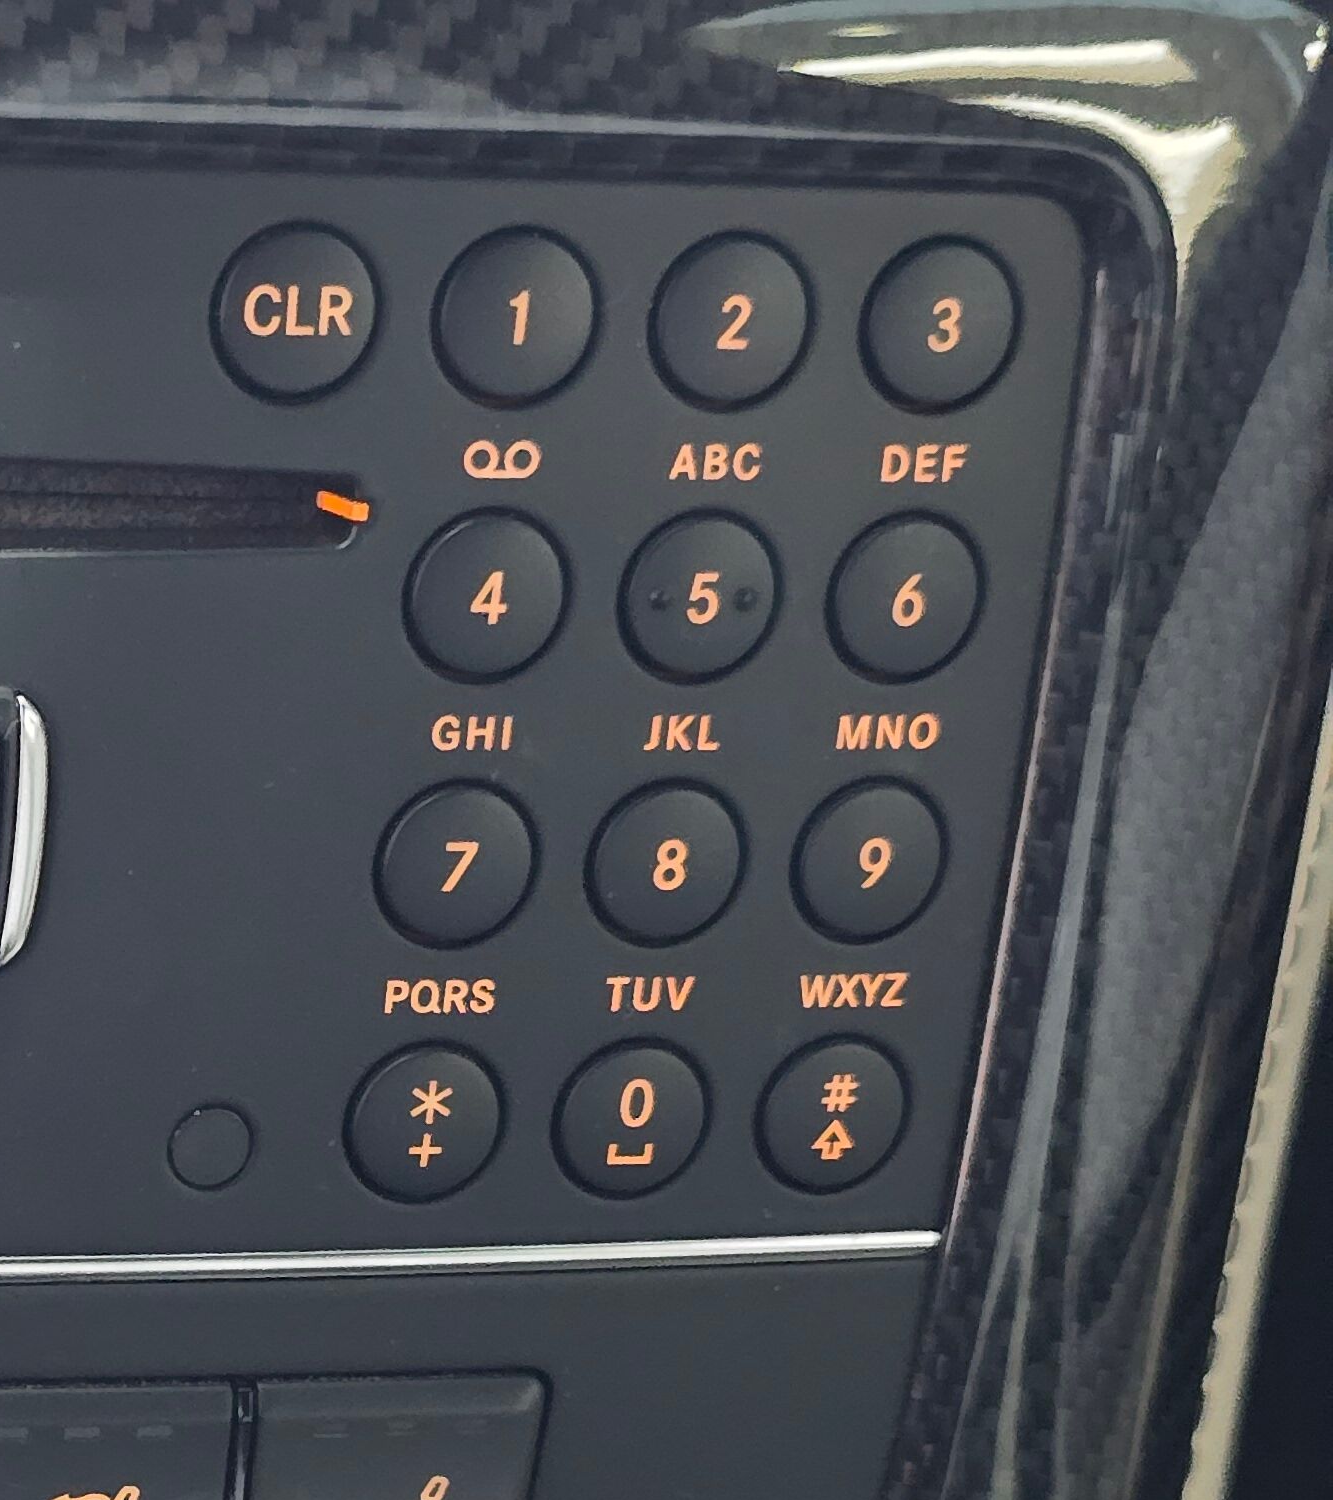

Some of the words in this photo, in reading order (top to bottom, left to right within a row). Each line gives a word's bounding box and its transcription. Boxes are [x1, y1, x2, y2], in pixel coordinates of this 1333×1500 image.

[243, 283, 354, 337] CLR
[509, 290, 530, 346] 1
[716, 294, 753, 350] 2
[927, 297, 962, 353] 3
[669, 443, 761, 481] ABC
[880, 443, 968, 483] DEF
[470, 570, 508, 625] 4
[686, 571, 720, 625] 5
[892, 573, 925, 627] 6
[431, 714, 513, 752] GHI
[643, 714, 720, 751] JKL
[835, 712, 940, 750] MNO
[441, 841, 480, 892] 7
[652, 839, 688, 891] 8
[859, 837, 892, 889] 9
[384, 978, 496, 1014] PQRS
[605, 975, 696, 1013] TUV
[800, 972, 908, 1009] WXYZ
[619, 1078, 655, 1128] 0
